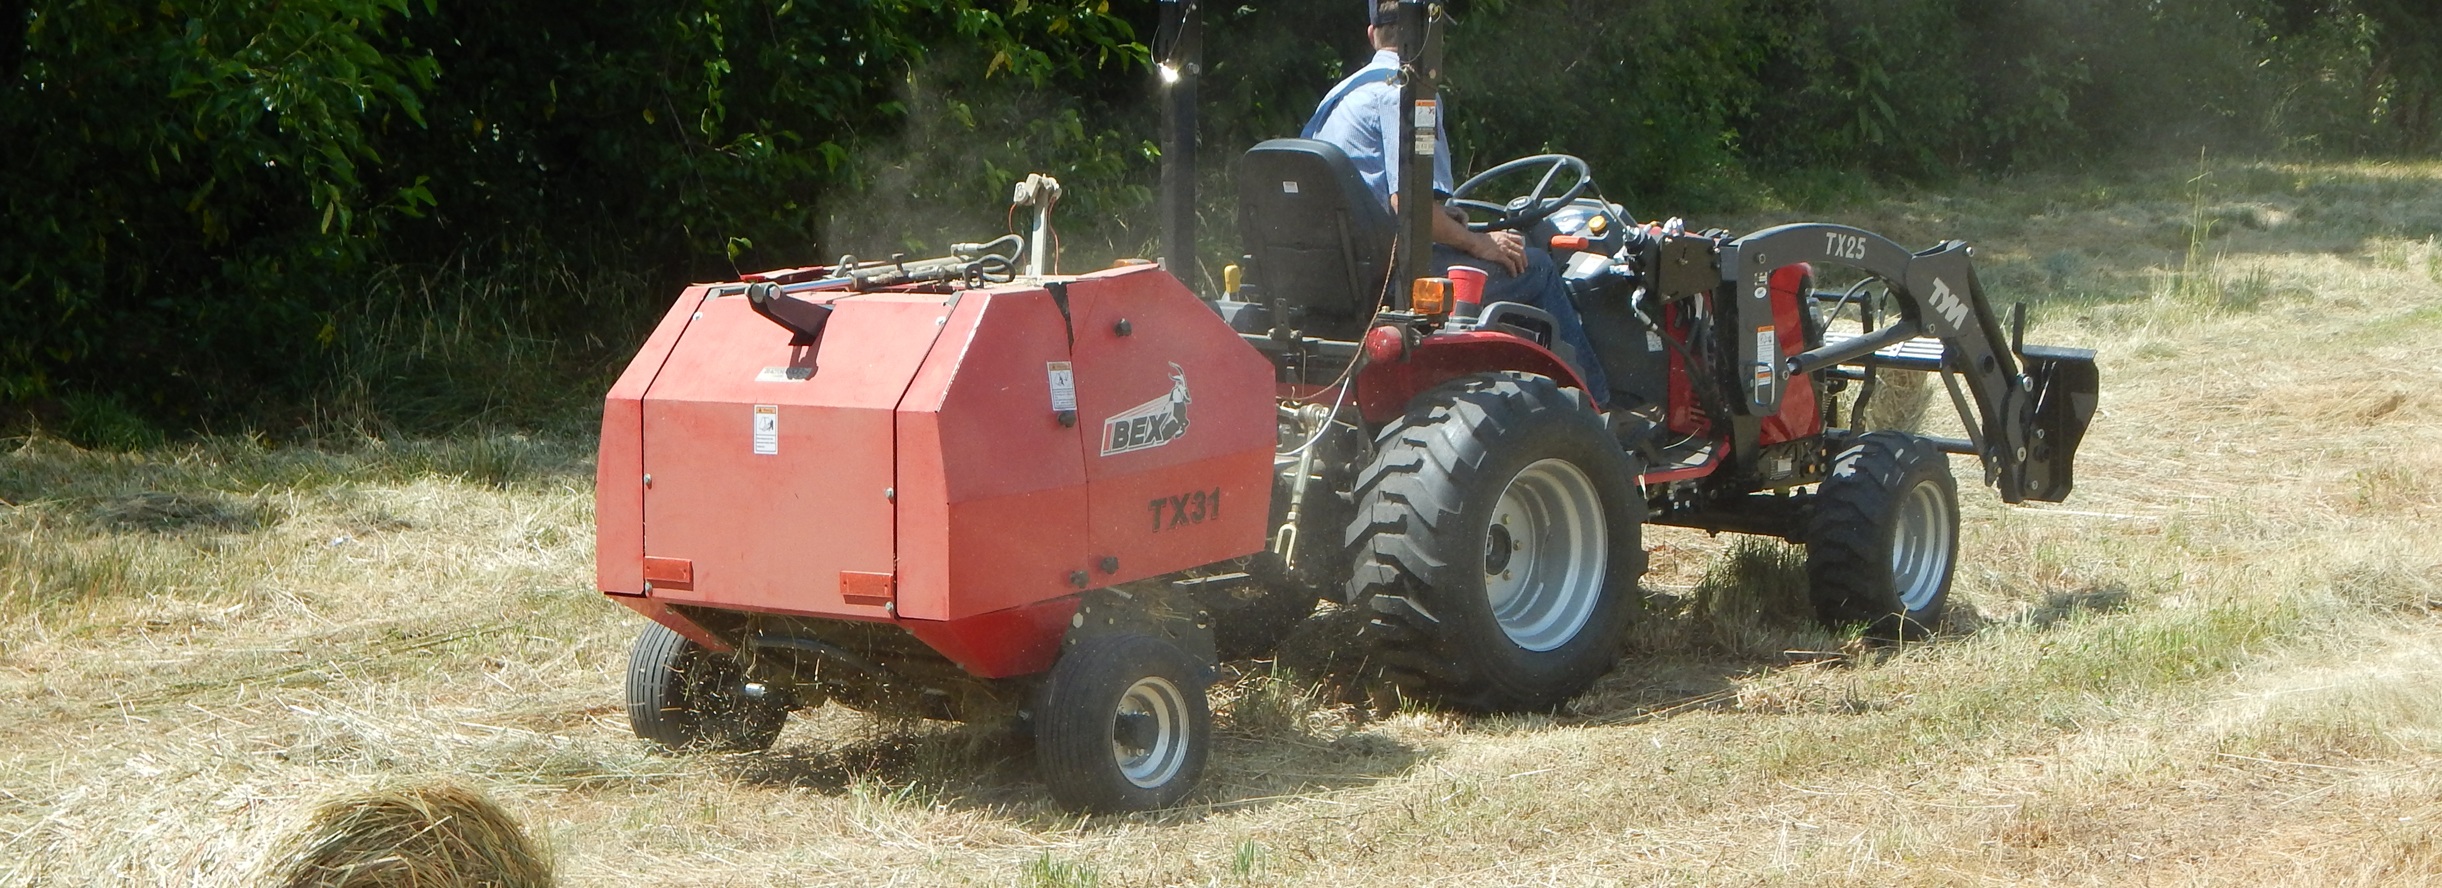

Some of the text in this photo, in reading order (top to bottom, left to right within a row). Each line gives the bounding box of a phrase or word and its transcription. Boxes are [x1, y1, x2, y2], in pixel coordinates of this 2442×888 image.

[1826, 232, 1867, 260] TX25
[1928, 277, 1969, 331] TYM
[1149, 487, 1221, 533] TX31
